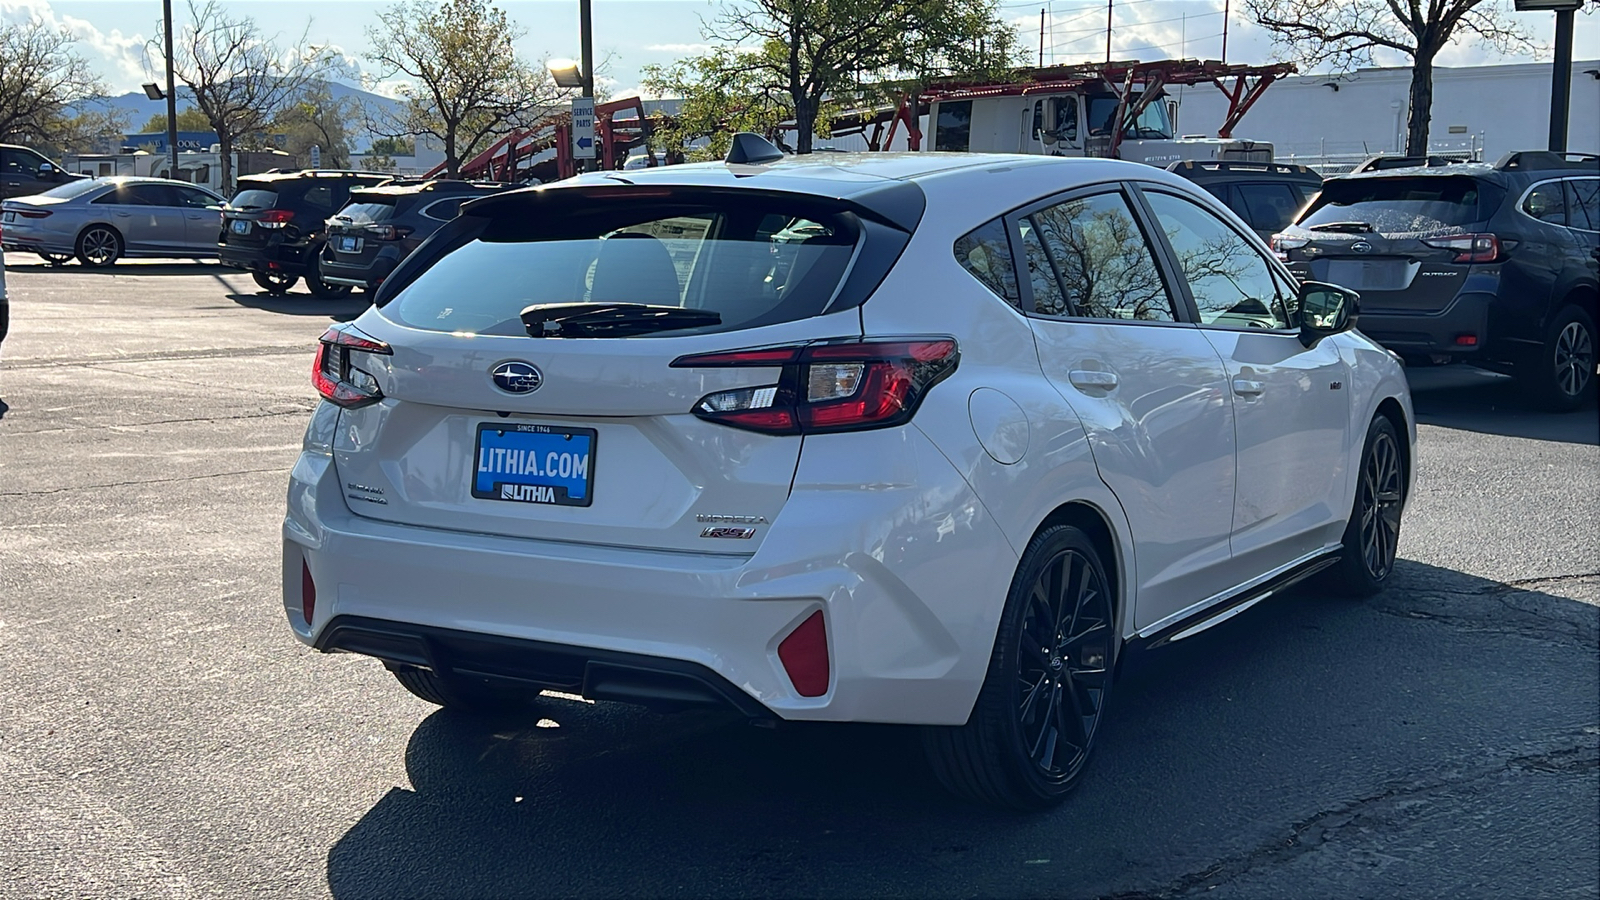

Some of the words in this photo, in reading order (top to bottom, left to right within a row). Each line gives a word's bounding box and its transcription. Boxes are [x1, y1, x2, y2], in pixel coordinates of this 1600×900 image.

[573, 107, 593, 117] SERVICE
[576, 119, 591, 128] PARTS
[177, 140, 200, 148] OOKS
[517, 424, 535, 433] SINCE
[536, 426, 551, 434] 1946
[478, 447, 589, 480] LITHIA.COM
[513, 484, 556, 503] LITHIA
[696, 513, 770, 525] IMPREZA
